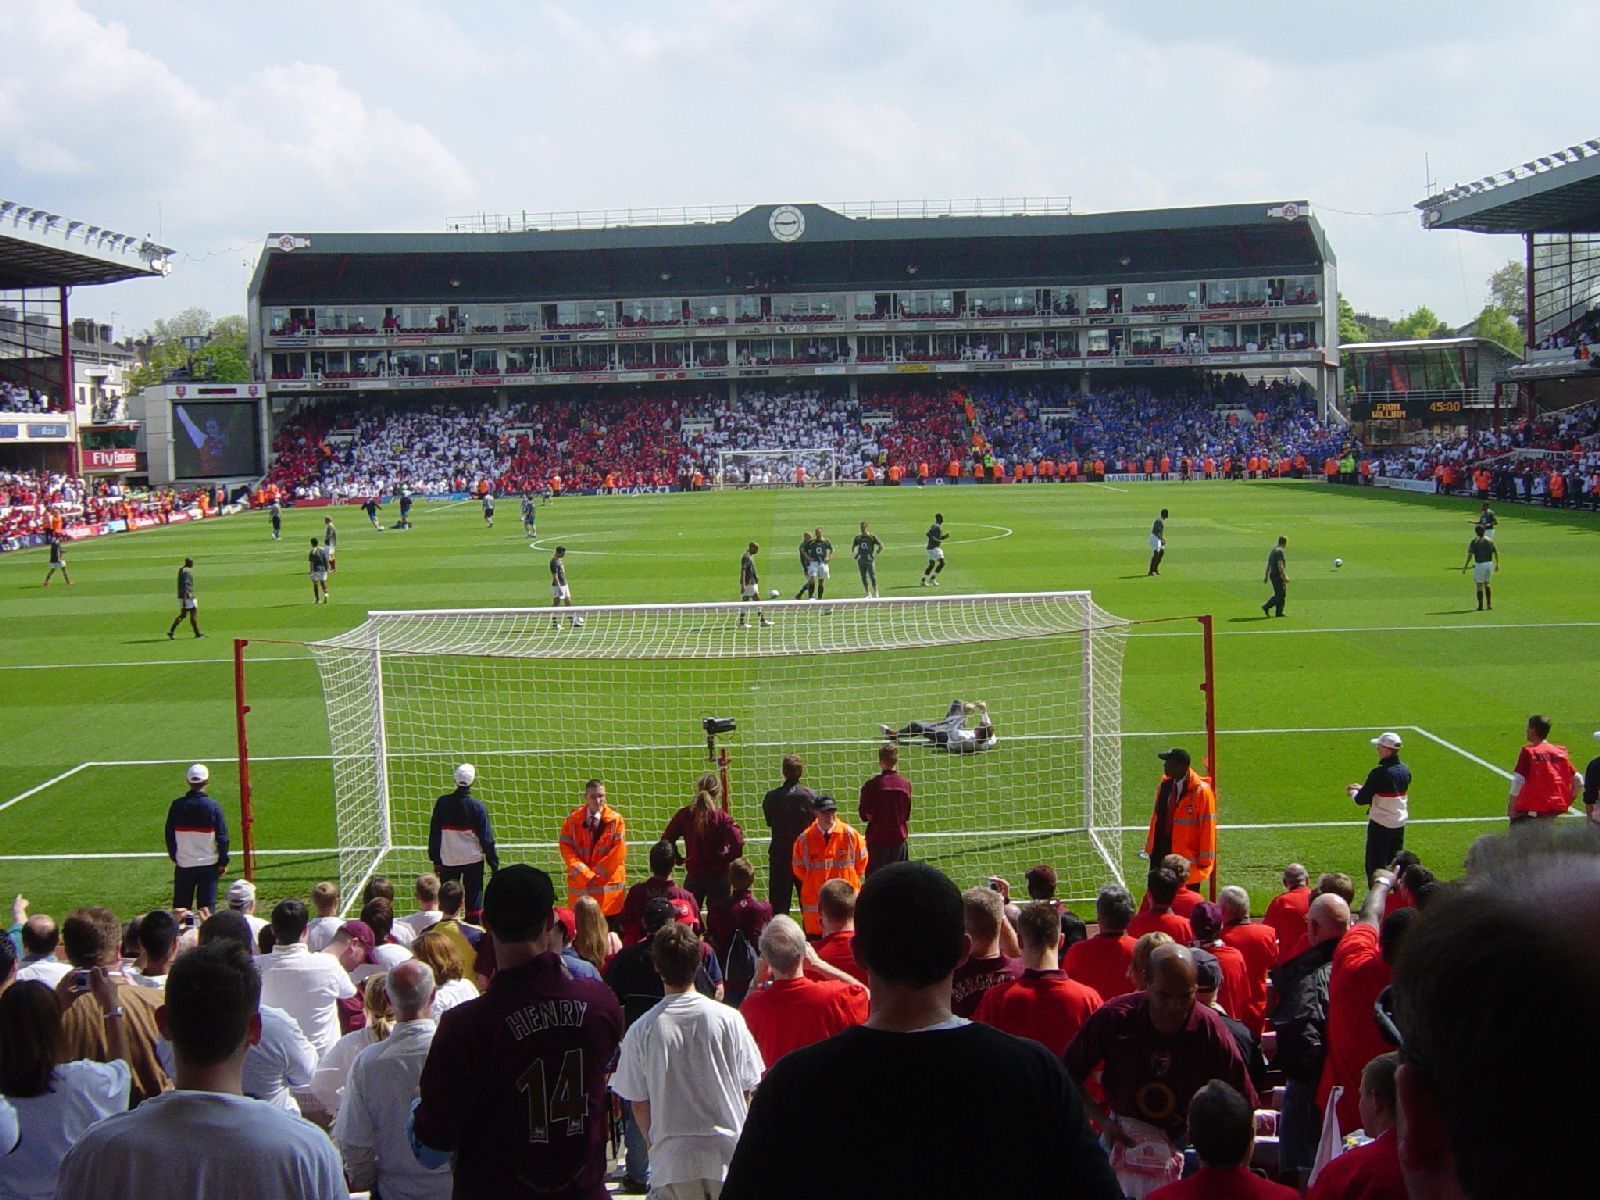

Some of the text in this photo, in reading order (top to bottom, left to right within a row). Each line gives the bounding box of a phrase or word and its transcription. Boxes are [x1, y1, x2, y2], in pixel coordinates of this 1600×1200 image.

[1376, 403, 1401, 411] FROM
[1429, 401, 1460, 412] 45:00
[93, 451, 113, 466] Fly
[505, 1000, 588, 1040] HENRY
[516, 1048, 589, 1143] 14
